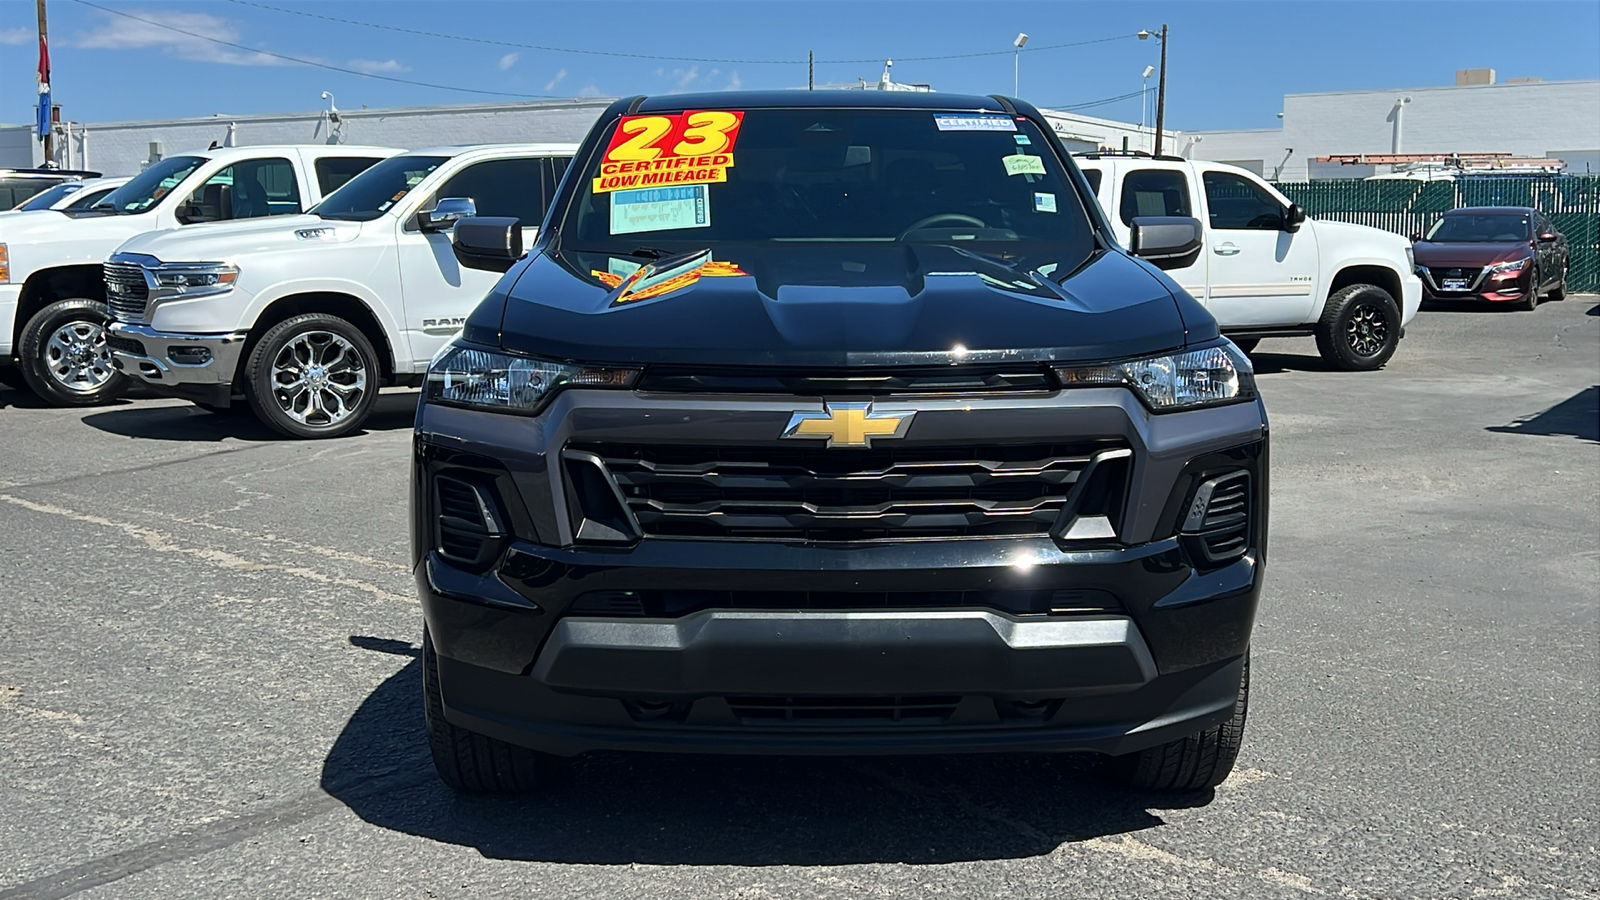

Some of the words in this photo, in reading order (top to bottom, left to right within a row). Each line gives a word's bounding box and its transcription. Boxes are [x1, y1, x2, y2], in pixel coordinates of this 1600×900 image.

[940, 119, 1010, 127] CERTIFIED
[608, 112, 739, 161] 23
[602, 155, 729, 174] CERTIFIED
[600, 174, 640, 190] LOW
[641, 168, 720, 186] MILEAGE
[423, 317, 466, 327] RAM
